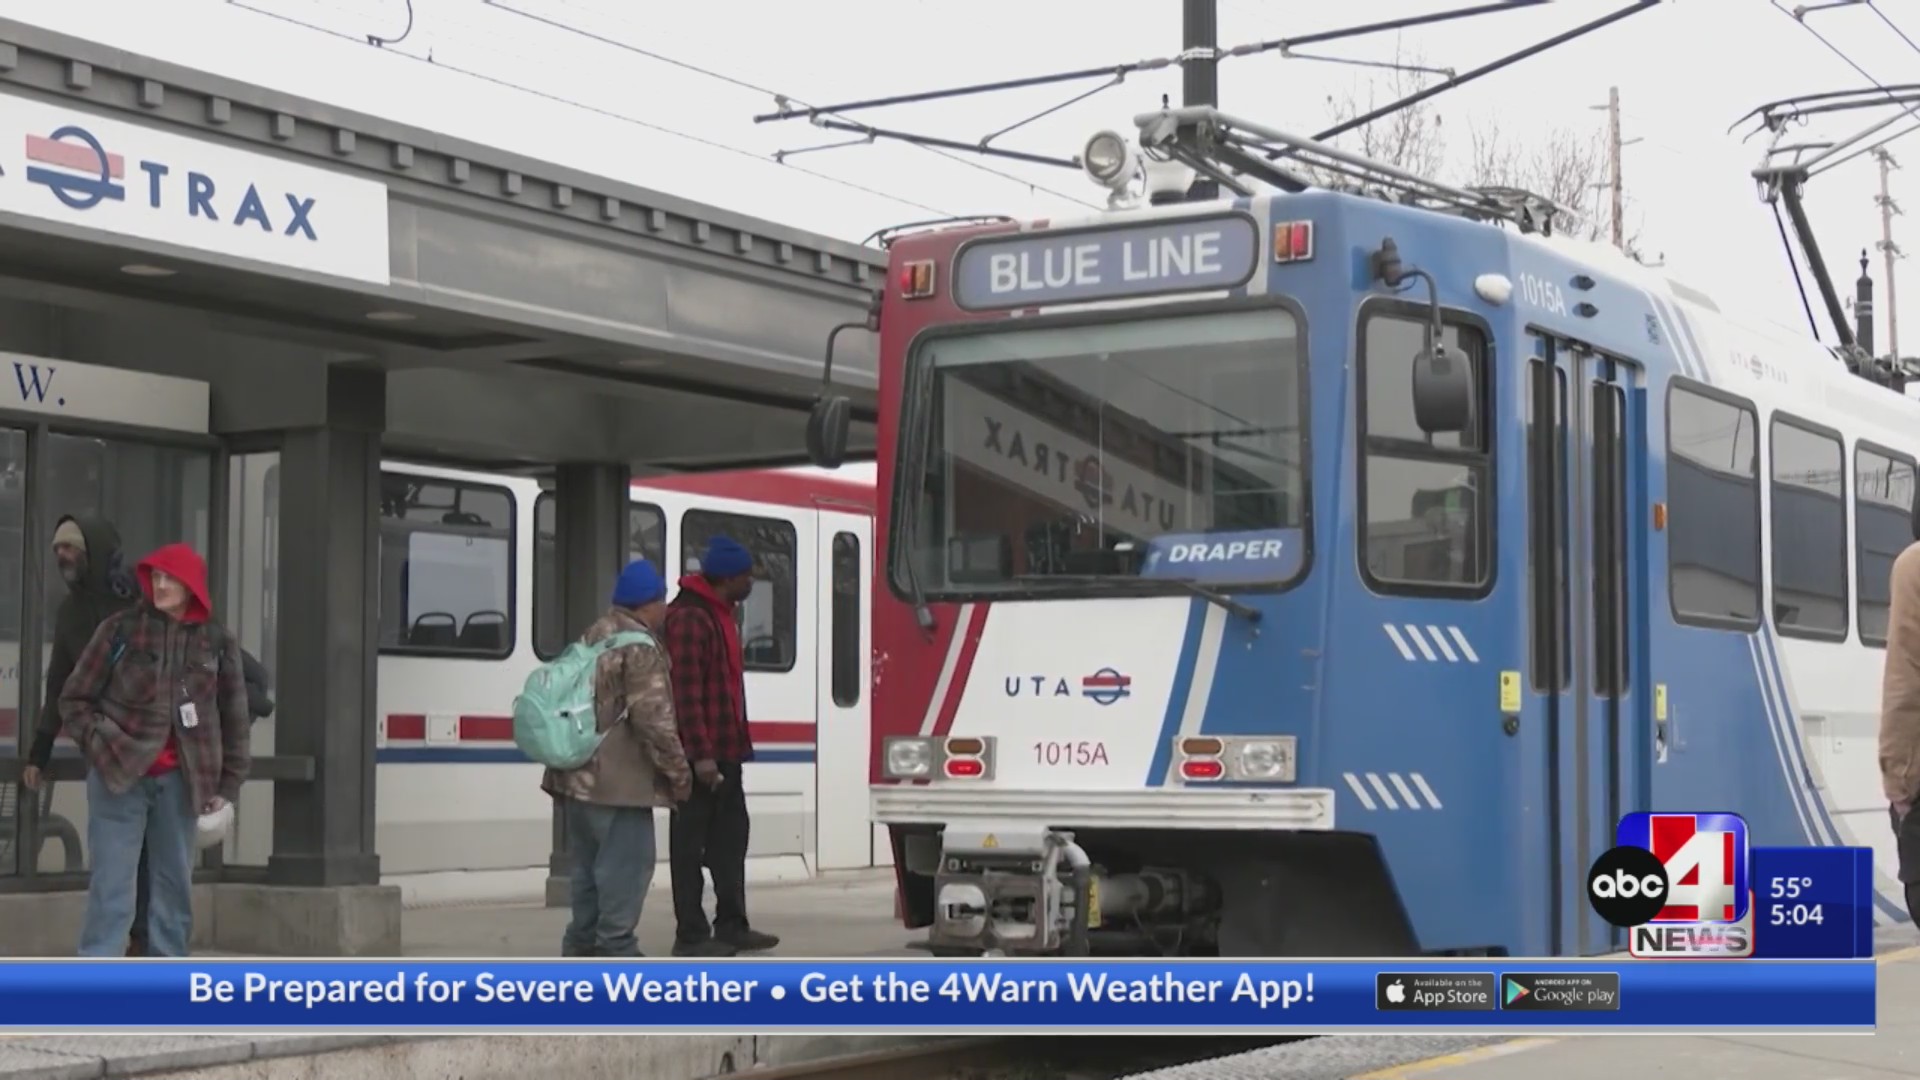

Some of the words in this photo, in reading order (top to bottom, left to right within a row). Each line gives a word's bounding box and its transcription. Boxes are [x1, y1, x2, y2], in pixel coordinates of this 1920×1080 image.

[140, 160, 318, 241] TRAX
[990, 245, 1100, 294] BLUE
[1123, 232, 1222, 281] LINE
[1519, 272, 1567, 318] 1015A
[13, 362, 66, 407] W.
[1168, 539, 1281, 563] DRAPER
[1005, 676, 1070, 698] UTA
[1033, 741, 1109, 766] 1015A
